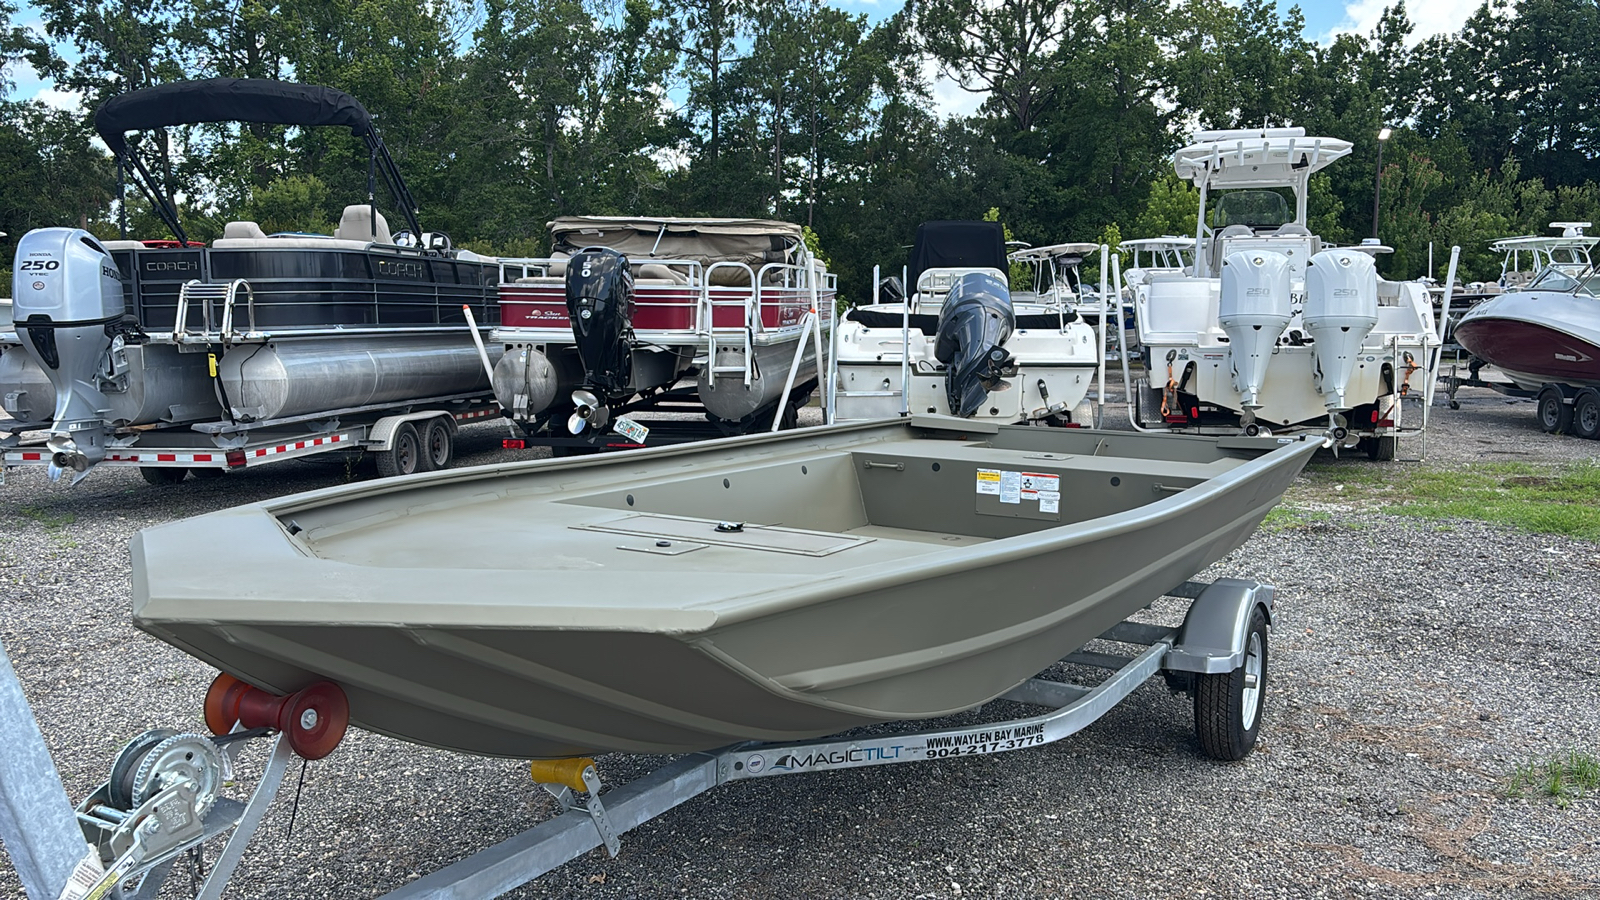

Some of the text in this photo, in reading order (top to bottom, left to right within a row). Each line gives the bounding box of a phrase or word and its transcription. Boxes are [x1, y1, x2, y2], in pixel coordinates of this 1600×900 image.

[20, 260, 60, 271] 250
[146, 261, 198, 271] COACH
[379, 261, 423, 278] COACH
[1246, 287, 1270, 295] 250
[1333, 288, 1358, 296] 250
[926, 723, 1045, 749] WWW.WAYLEN BAY MARINE
[926, 734, 1045, 758] 904-217-3778
[791, 745, 904, 768] MAGICTILT
